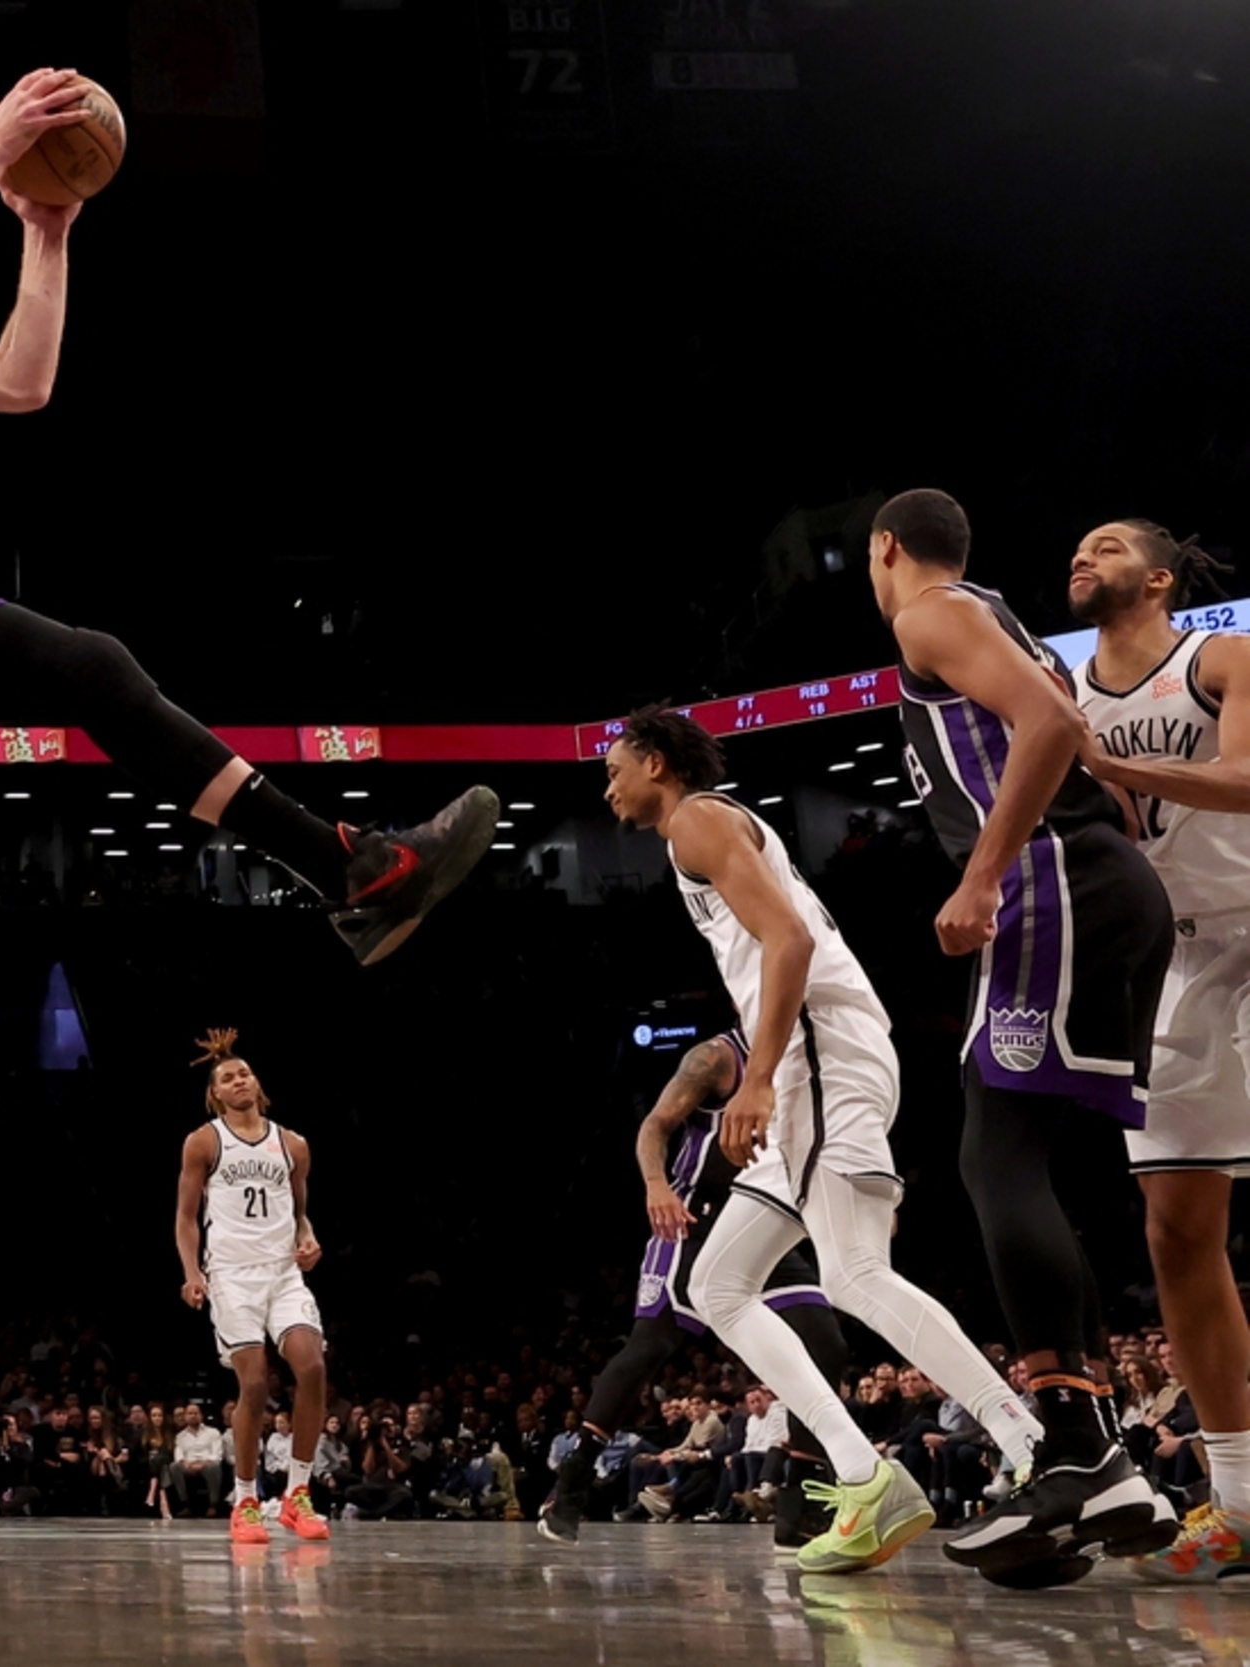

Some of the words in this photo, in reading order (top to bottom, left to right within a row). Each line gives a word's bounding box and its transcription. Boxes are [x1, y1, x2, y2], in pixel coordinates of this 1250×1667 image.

[507, 49, 583, 94] 72
[1181, 606, 1237, 631] 4:52
[799, 683, 829, 699] REB
[849, 673, 878, 690] AST
[594, 741, 609, 754] 17
[993, 1034, 1044, 1048] KINGS
[220, 1160, 286, 1186] BROOKLYN
[244, 1186, 268, 1218] 21
